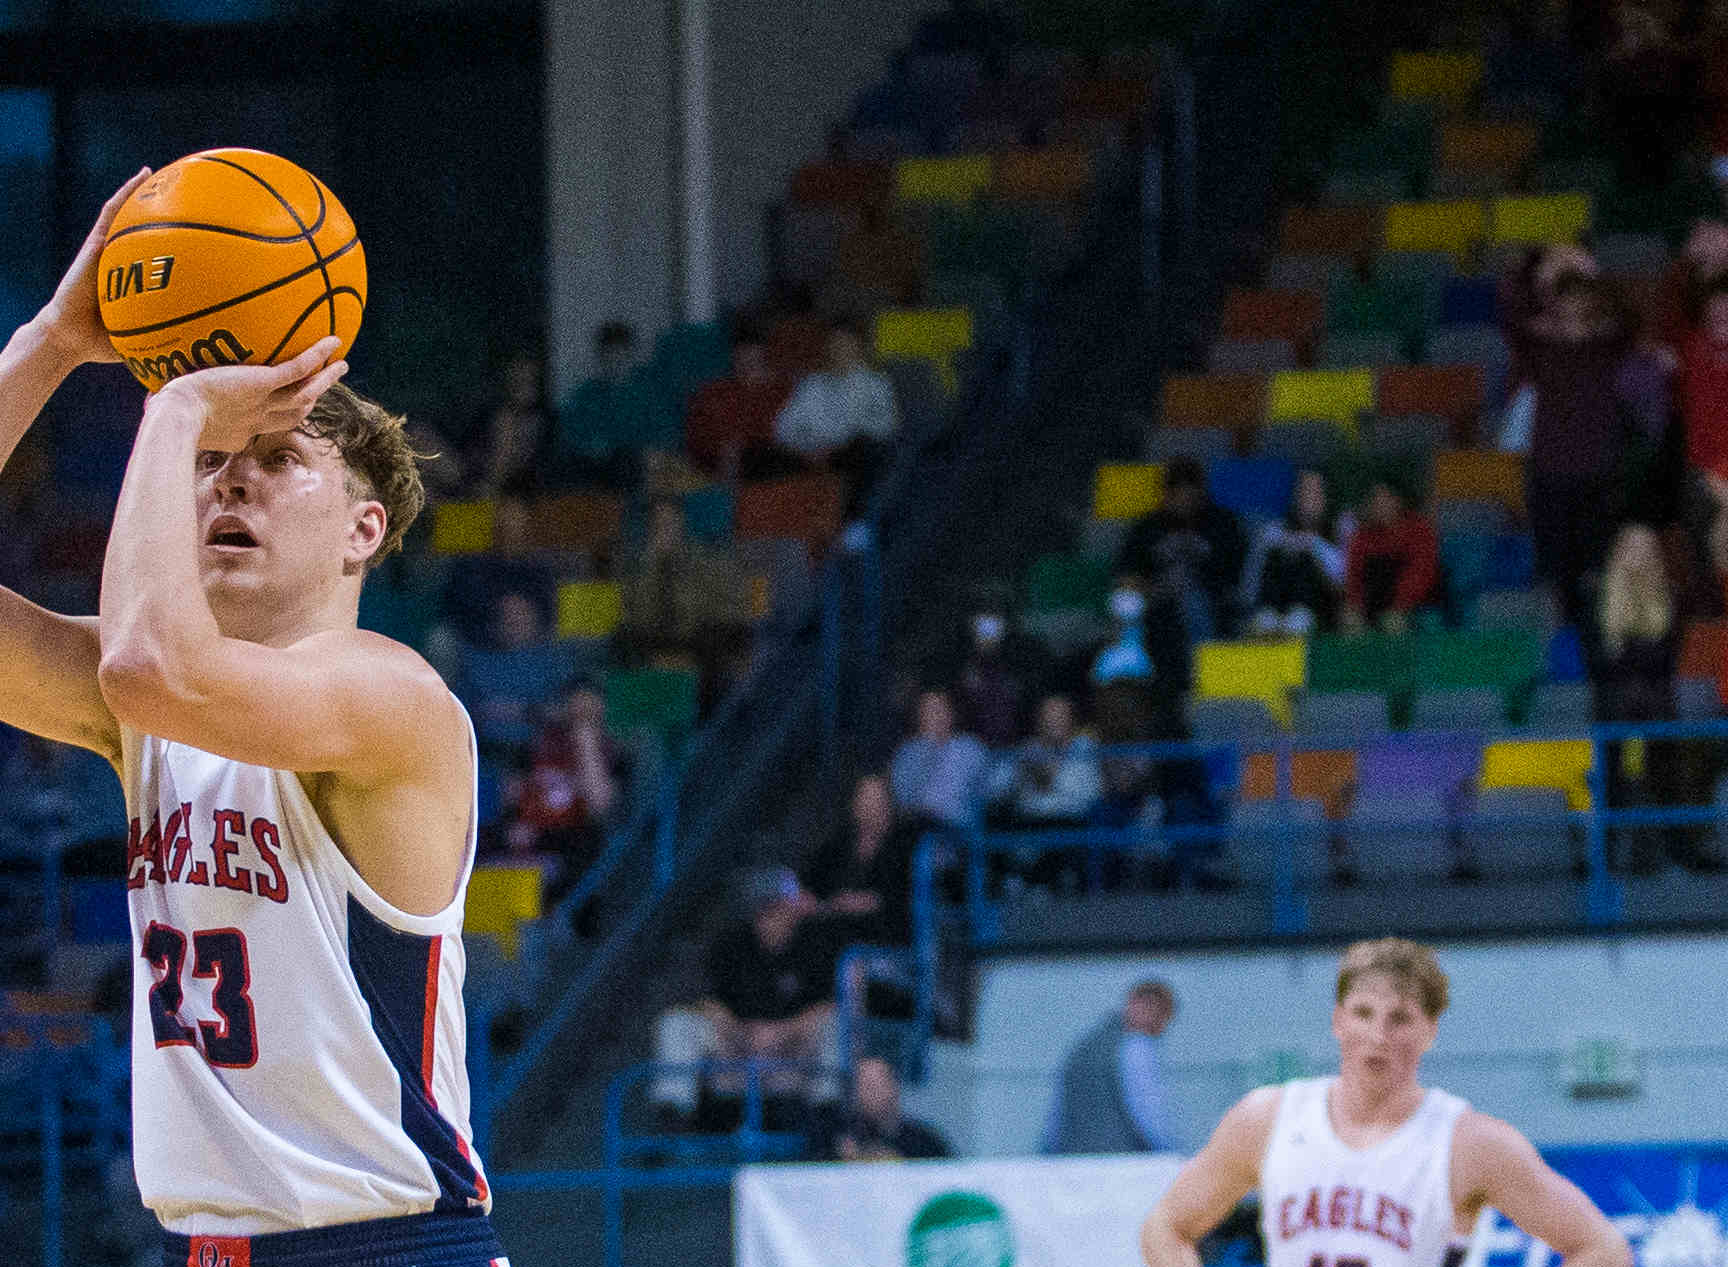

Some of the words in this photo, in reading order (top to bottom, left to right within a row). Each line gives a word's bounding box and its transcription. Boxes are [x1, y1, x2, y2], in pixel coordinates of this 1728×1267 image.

[105, 254, 175, 303] EVO
[127, 801, 290, 905] EAGLES
[140, 919, 260, 1069] 23
[1279, 1184, 1415, 1252] EAGLES
